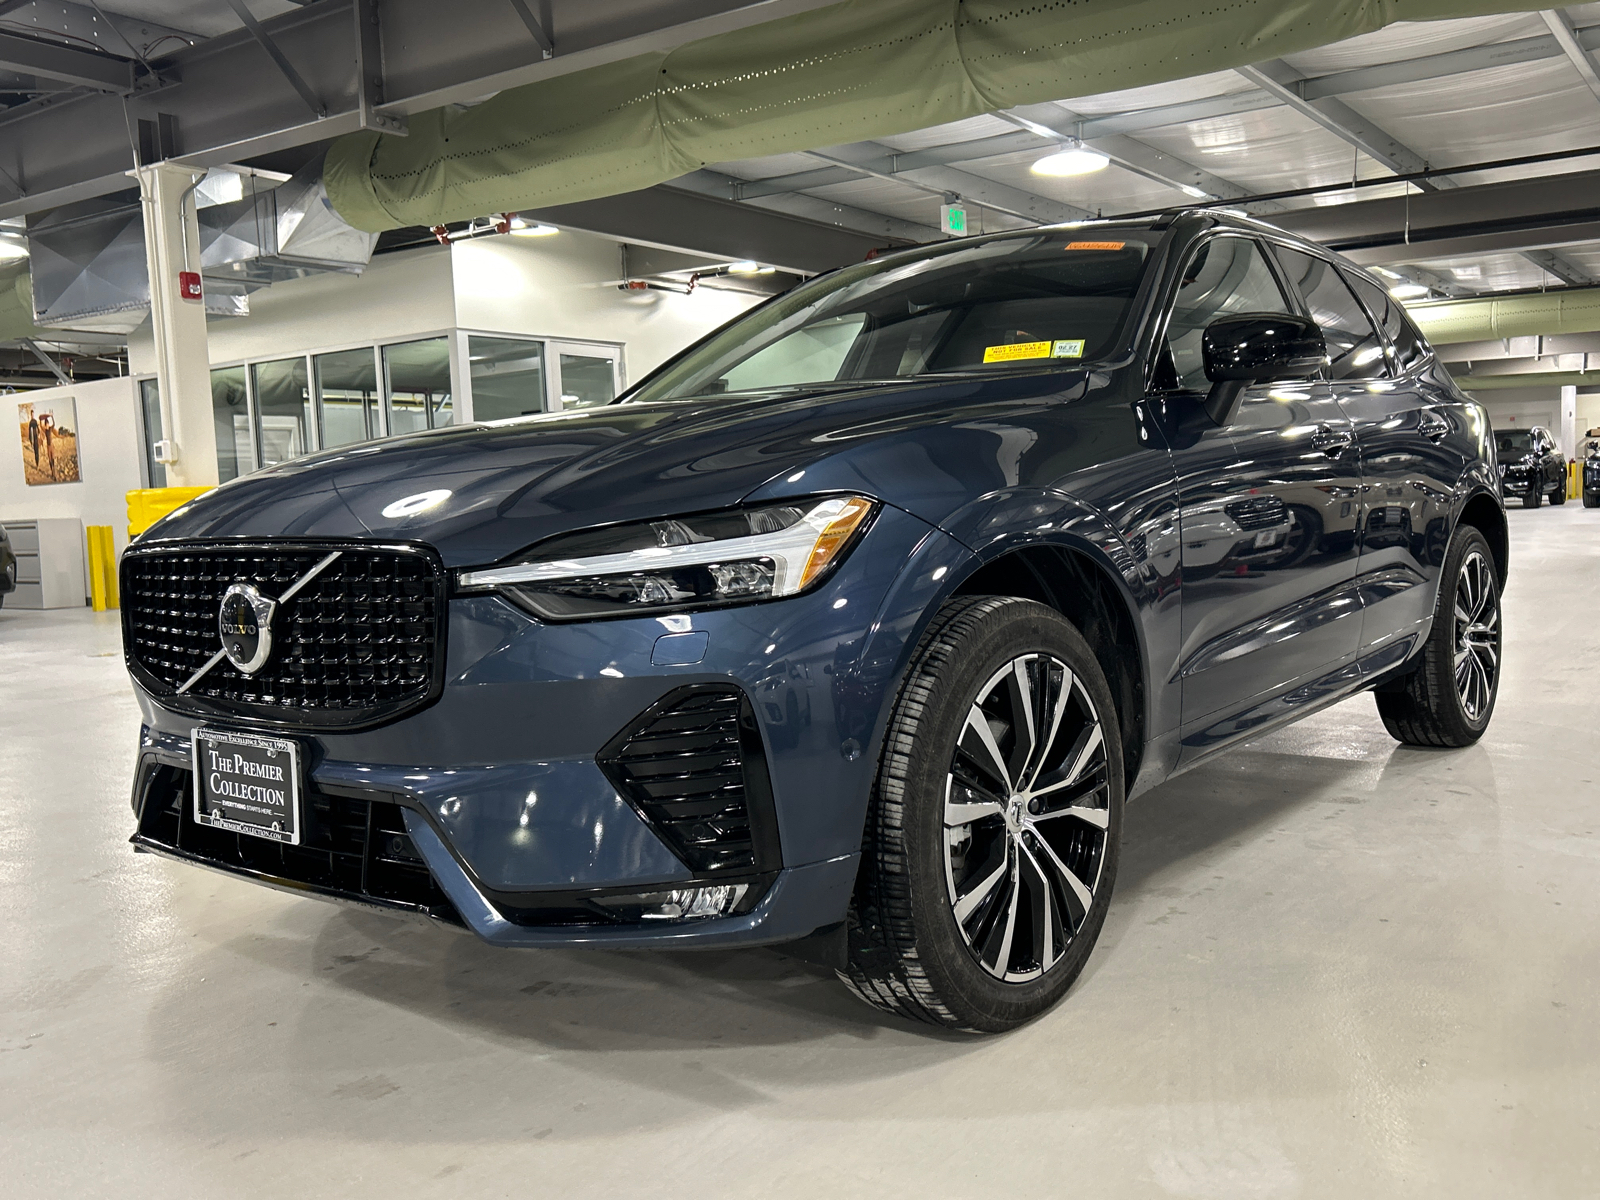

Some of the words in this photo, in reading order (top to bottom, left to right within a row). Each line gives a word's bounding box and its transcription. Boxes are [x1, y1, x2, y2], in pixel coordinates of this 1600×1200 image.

[221, 623, 257, 635] VOLVO
[198, 731, 228, 741] AUTOMOTIVE
[228, 734, 257, 746] EXCELLENCE
[258, 739, 273, 748] SINCE
[273, 741, 289, 751] 1995
[208, 750, 233, 773] THE
[234, 754, 284, 782] PREMIER
[210, 772, 285, 807] COLLECTION
[222, 800, 247, 811] EVERYTHING
[246, 804, 261, 813] STARTS
